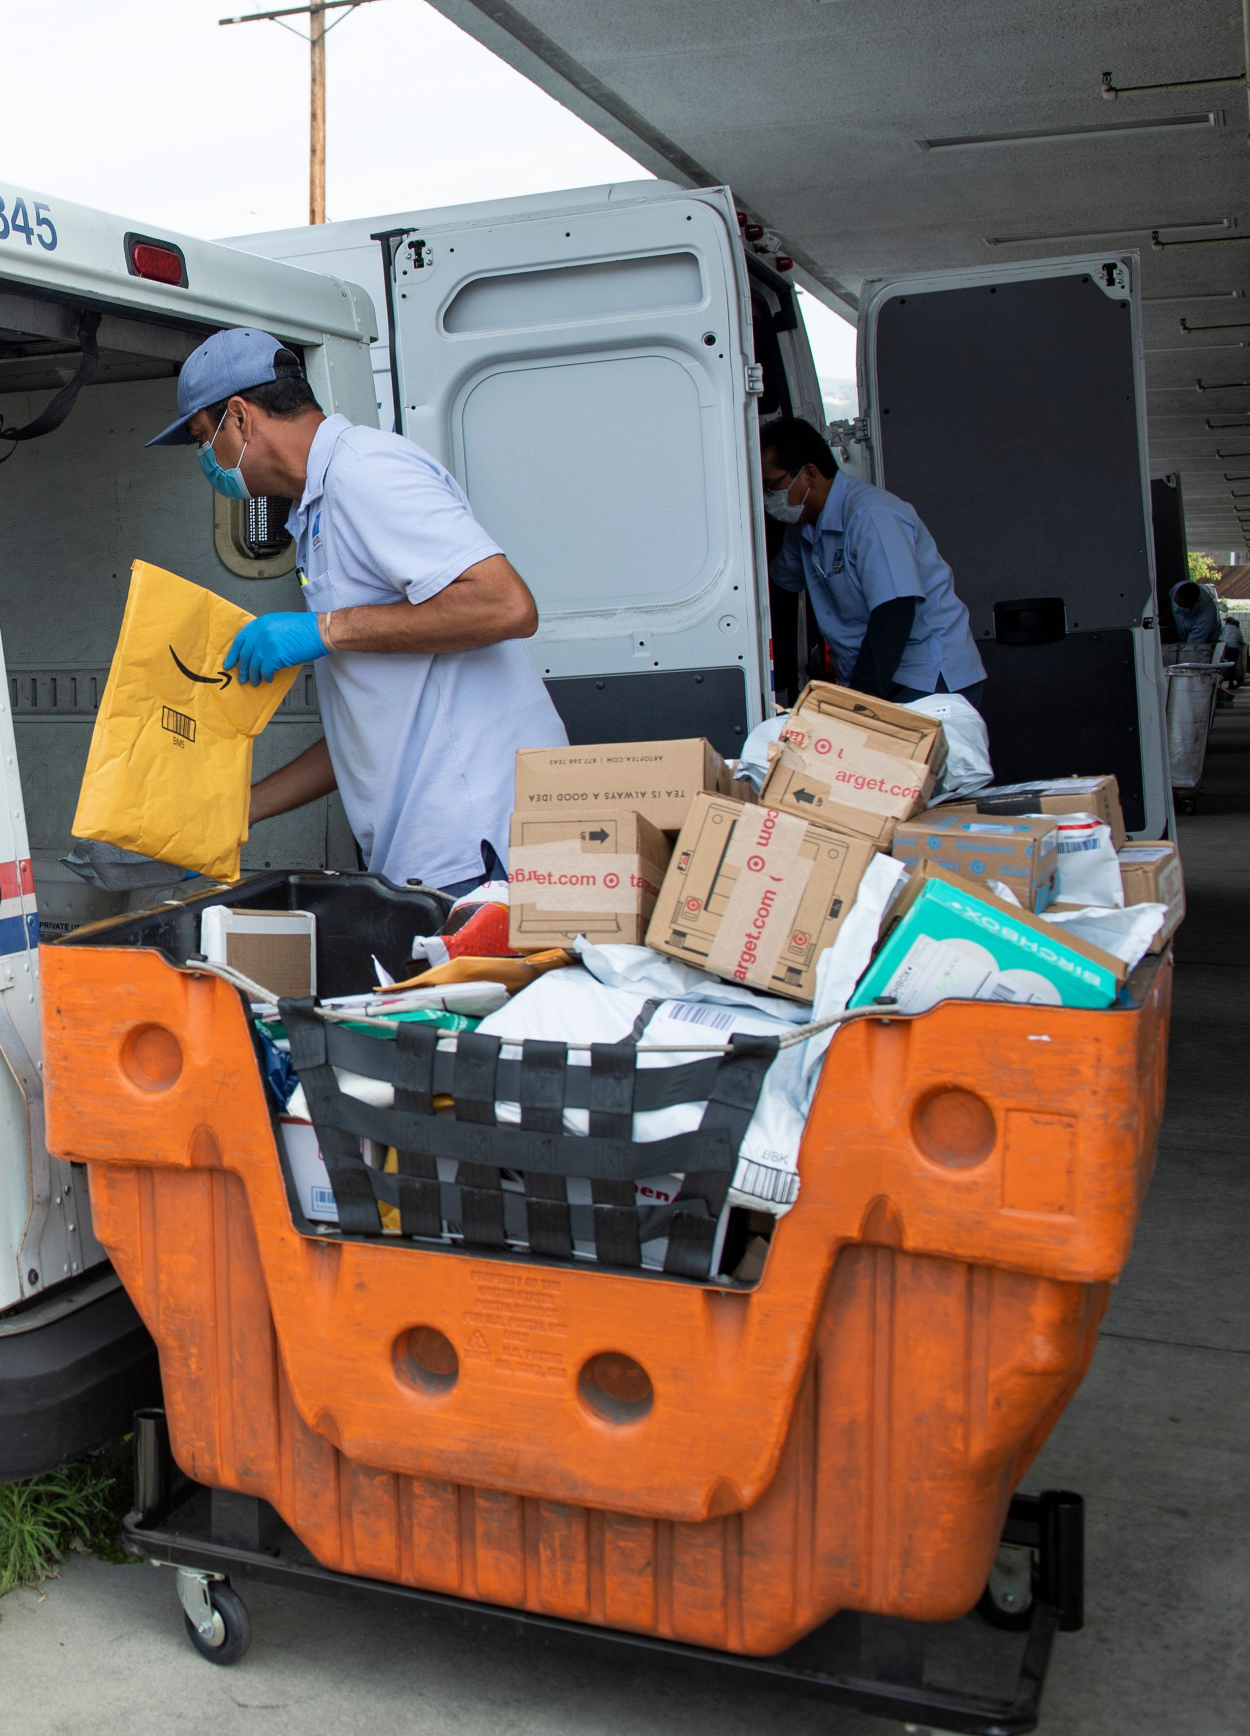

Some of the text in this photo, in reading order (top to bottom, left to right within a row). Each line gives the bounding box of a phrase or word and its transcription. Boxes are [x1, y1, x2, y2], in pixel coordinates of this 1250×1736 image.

[528, 789, 686, 803] TEA IS ALWAYS A GOOD IDEA
[39, 921, 70, 931] PRIVATE
[733, 888, 778, 983] arget.com
[960, 905, 1102, 987] BIRCHBOX
